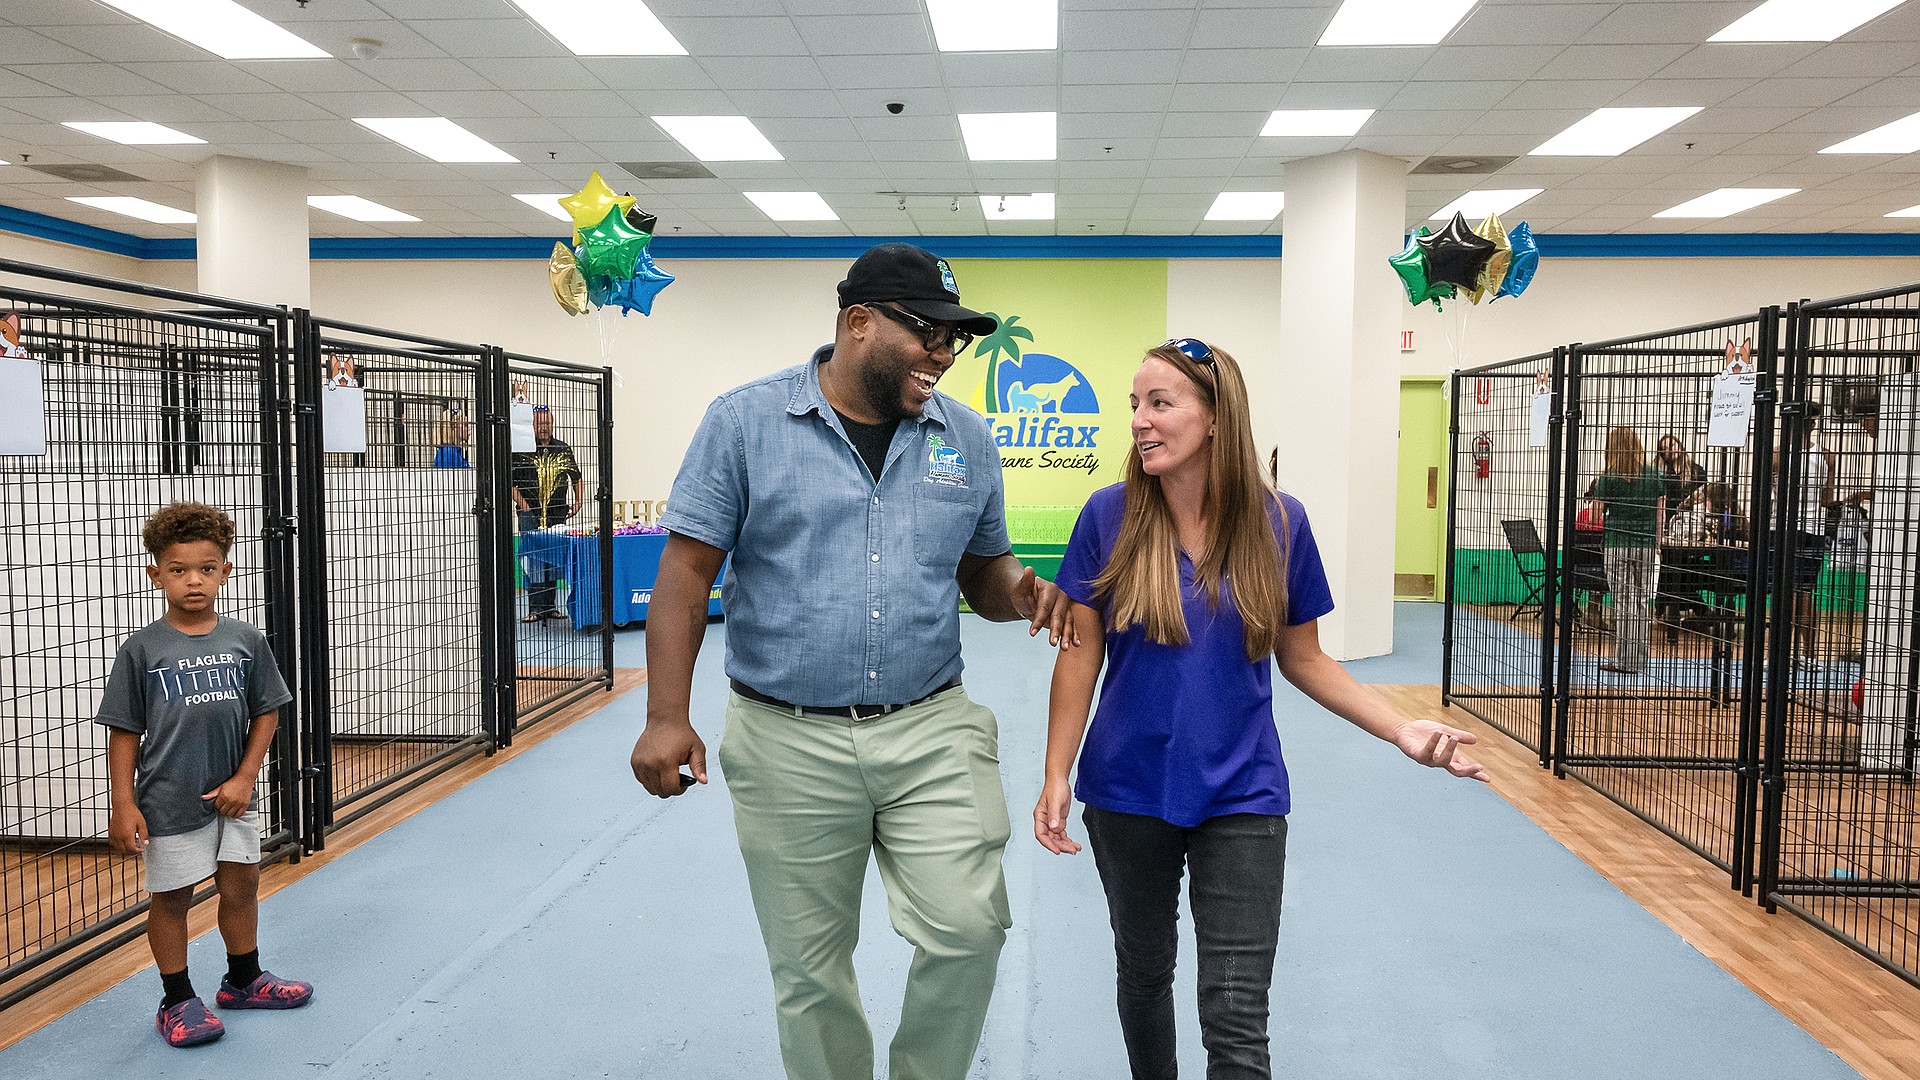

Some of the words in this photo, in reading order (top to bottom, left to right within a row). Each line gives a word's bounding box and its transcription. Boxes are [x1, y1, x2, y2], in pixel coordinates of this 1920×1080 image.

[1401, 330, 1414, 348] IT
[929, 462, 966, 477] Halifax
[1038, 450, 1100, 475] Society
[631, 592, 651, 604] Ado
[178, 654, 234, 670] FLAGLER
[147, 658, 252, 701] TITANS
[185, 689, 239, 706] FOOTBALL
